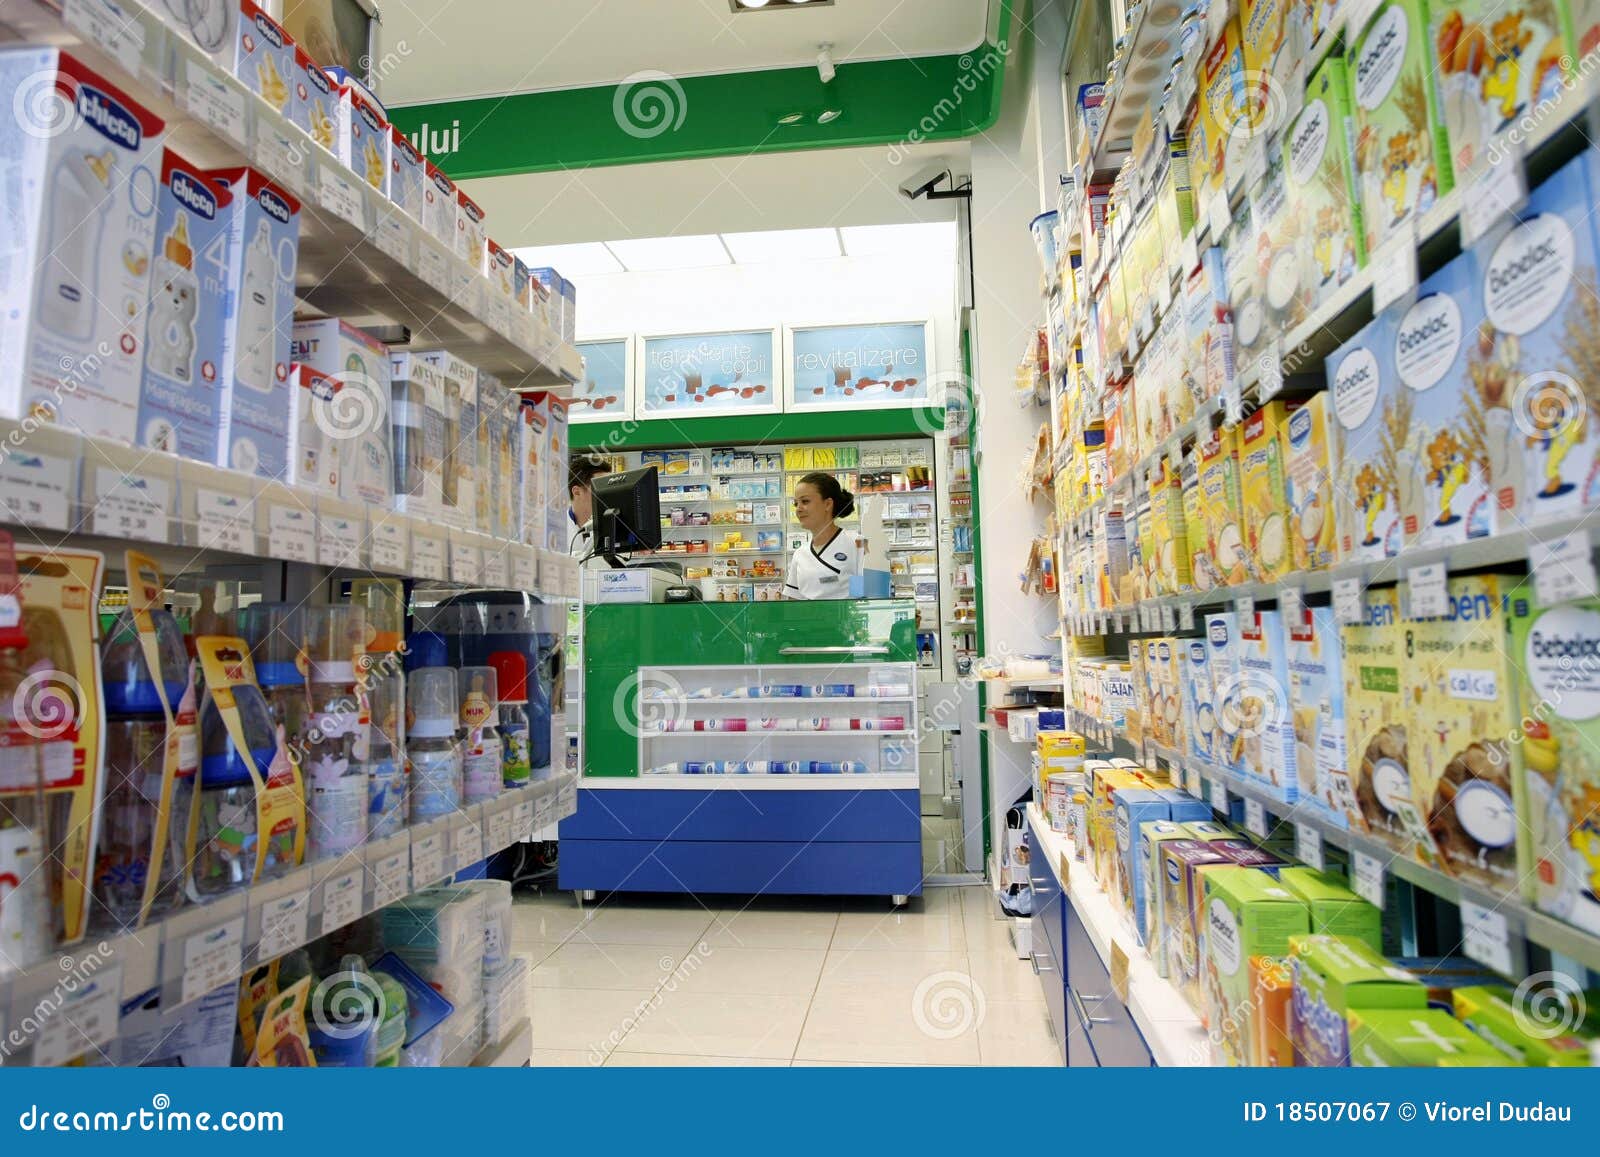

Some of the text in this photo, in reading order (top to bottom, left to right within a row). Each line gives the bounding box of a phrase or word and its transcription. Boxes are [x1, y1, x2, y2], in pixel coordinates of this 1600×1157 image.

[79, 93, 138, 147] chicco
[172, 173, 215, 219] chicco
[261, 194, 288, 220] chicco
[1399, 311, 1450, 354] Bebelac
[795, 344, 918, 372] revitalizare
[1335, 364, 1371, 397] Bebelac
[465, 706, 485, 717] NUK
